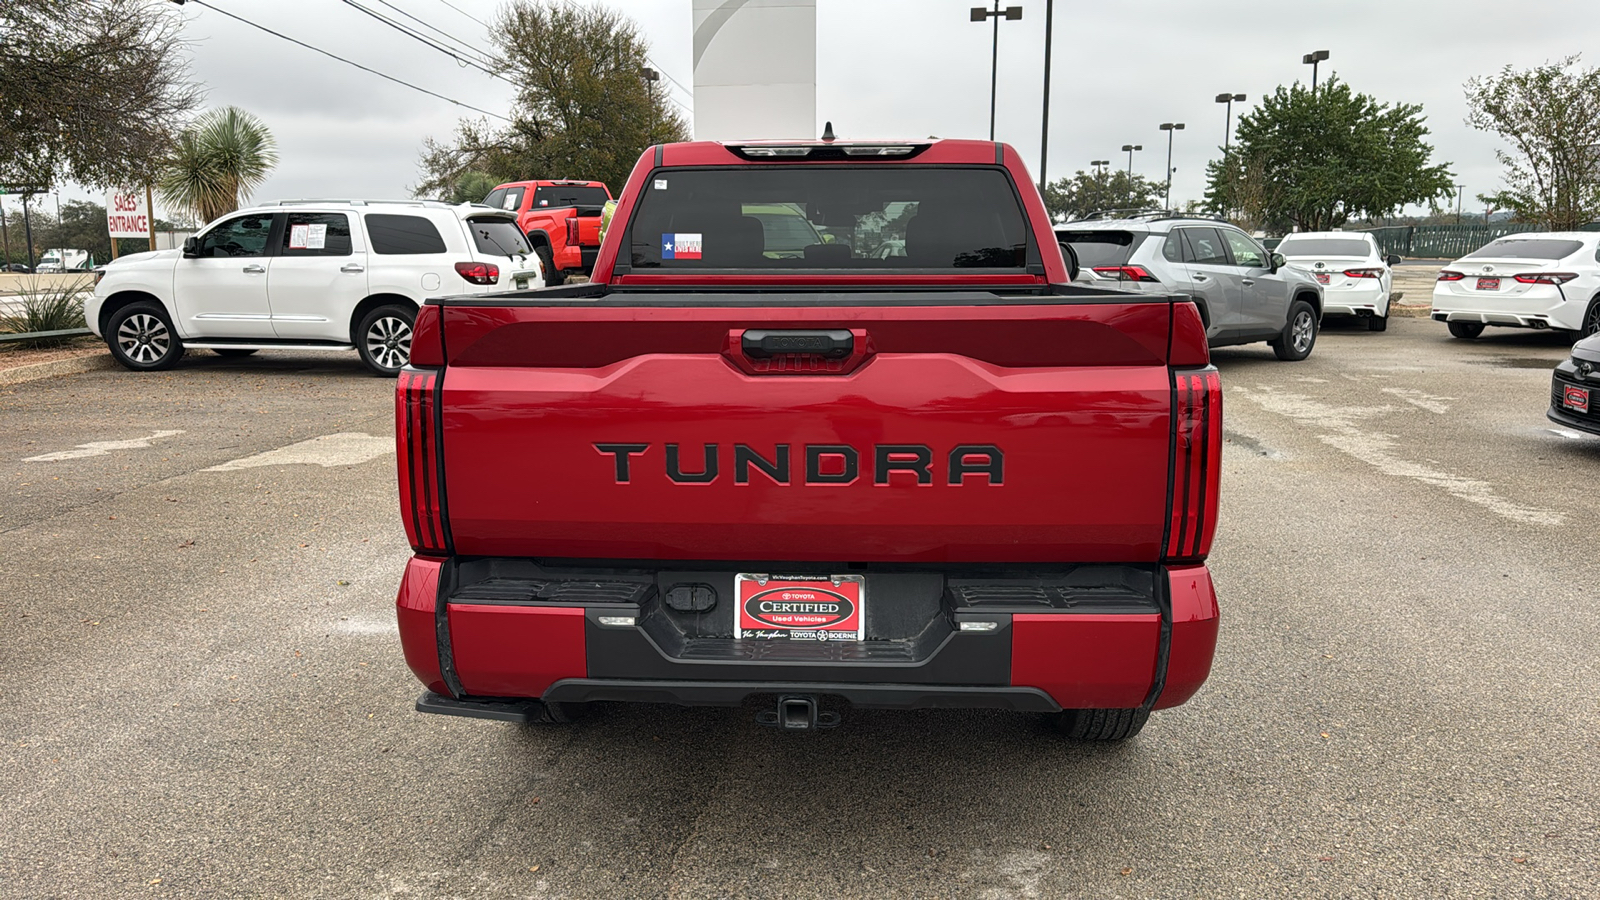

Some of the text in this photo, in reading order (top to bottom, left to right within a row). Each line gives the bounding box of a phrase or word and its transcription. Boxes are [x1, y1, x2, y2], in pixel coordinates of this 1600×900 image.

[114, 194, 136, 211] SALES
[109, 215, 147, 232] ENTRANCE
[773, 337, 823, 348] TOYOTA
[592, 443, 1005, 487] TUNDRA
